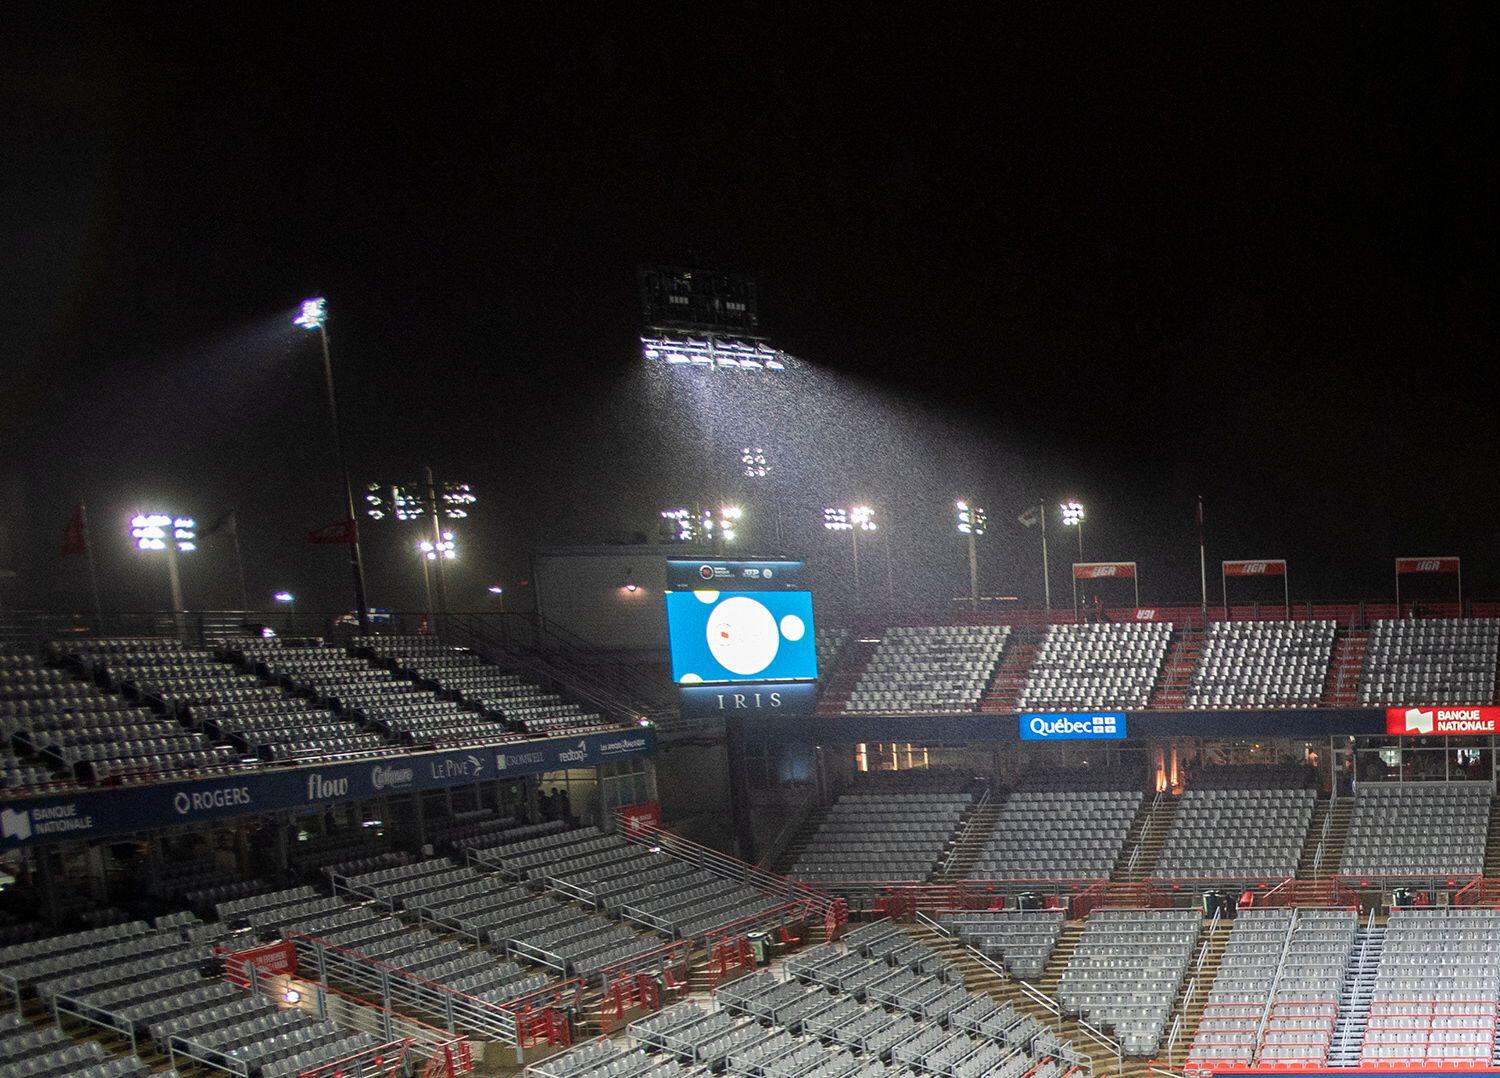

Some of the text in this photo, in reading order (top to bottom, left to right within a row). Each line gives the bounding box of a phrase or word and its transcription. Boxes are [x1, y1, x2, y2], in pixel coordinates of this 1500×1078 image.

[717, 692, 782, 710] IRIS
[1437, 710, 1481, 720] BANQUE
[1030, 717, 1092, 737] Québec
[1437, 720, 1495, 731] NATIONALE
[307, 772, 349, 801] flow
[190, 786, 251, 811] ROGERS
[32, 804, 77, 821] BANQUE
[35, 816, 93, 836] NATIONALE
